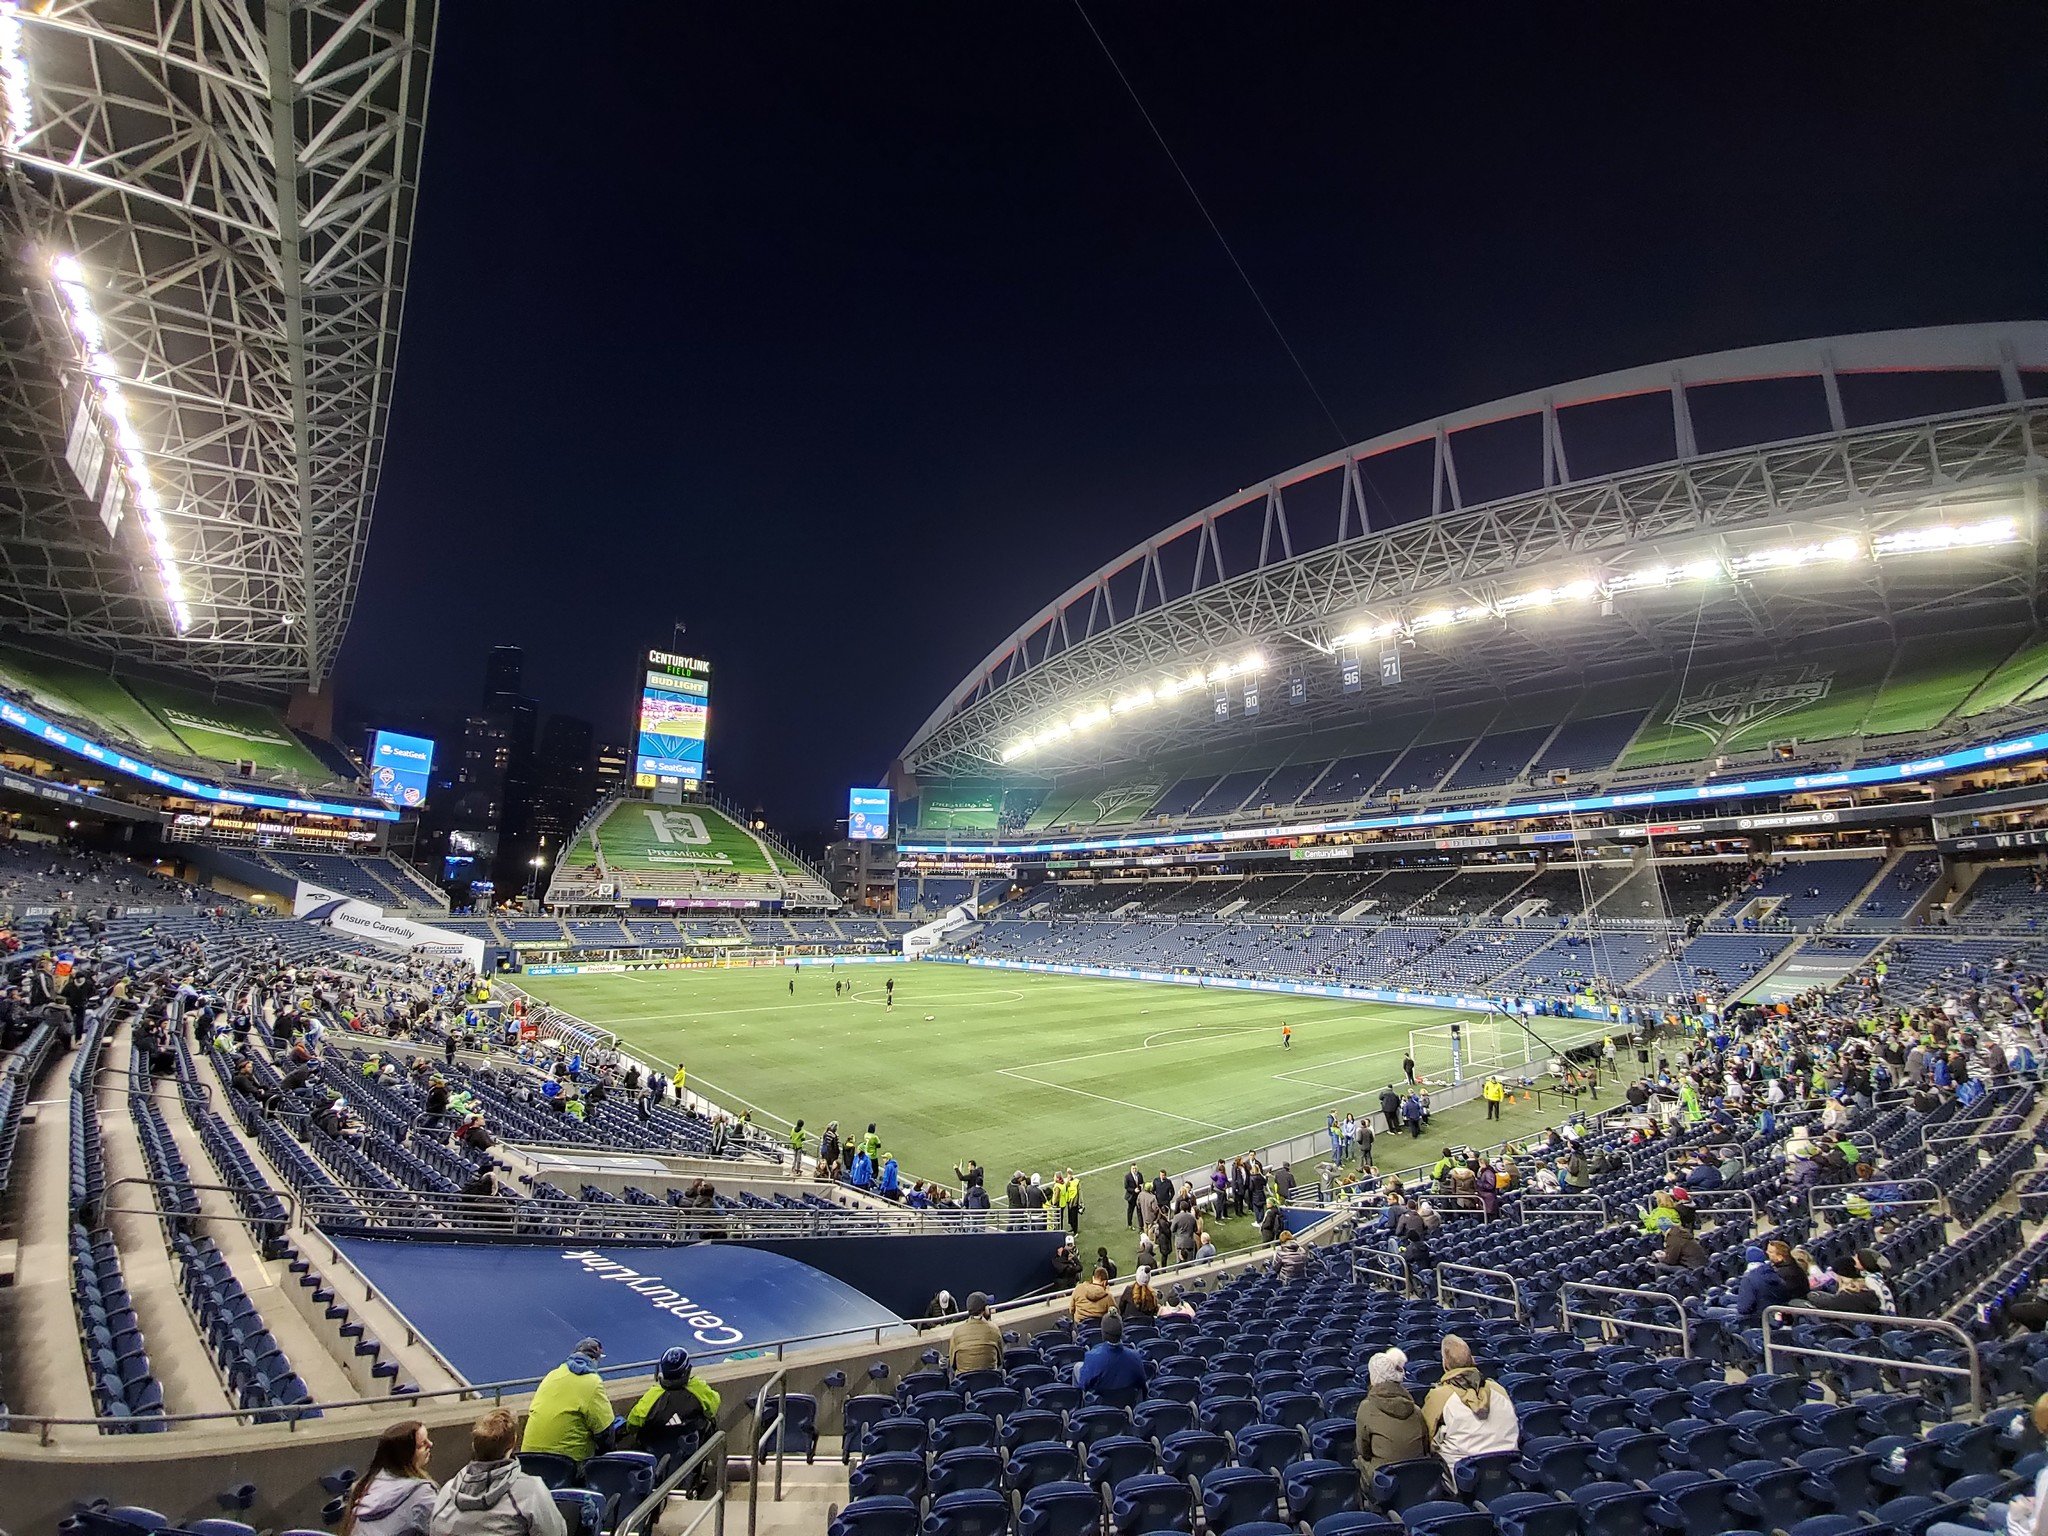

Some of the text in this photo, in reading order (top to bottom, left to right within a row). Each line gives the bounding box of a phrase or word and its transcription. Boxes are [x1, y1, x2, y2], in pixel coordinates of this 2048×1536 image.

[649, 650, 709, 673] CENTURYLINK
[666, 666, 692, 677] FIELD
[1383, 662, 1397, 677] 71
[651, 675, 703, 692] BUD LIGHT
[1344, 671, 1358, 685] 96
[1291, 684, 1303, 697] 12
[1246, 695, 1257, 708] 80
[1215, 702, 1227, 715] 45
[393, 747, 427, 760] SeatGeek
[658, 763, 697, 774] SeatGeek
[212, 818, 242, 829] MONSTER
[243, 821, 257, 830] JAM
[260, 823, 282, 834] MARCH
[293, 827, 332, 837] CENTURYLINK
[1453, 838, 1492, 847] DELTA
[1305, 848, 1348, 859] CenturyLink
[339, 911, 415, 940] Insure Carefully
[561, 1249, 744, 1346] CenturyLink
